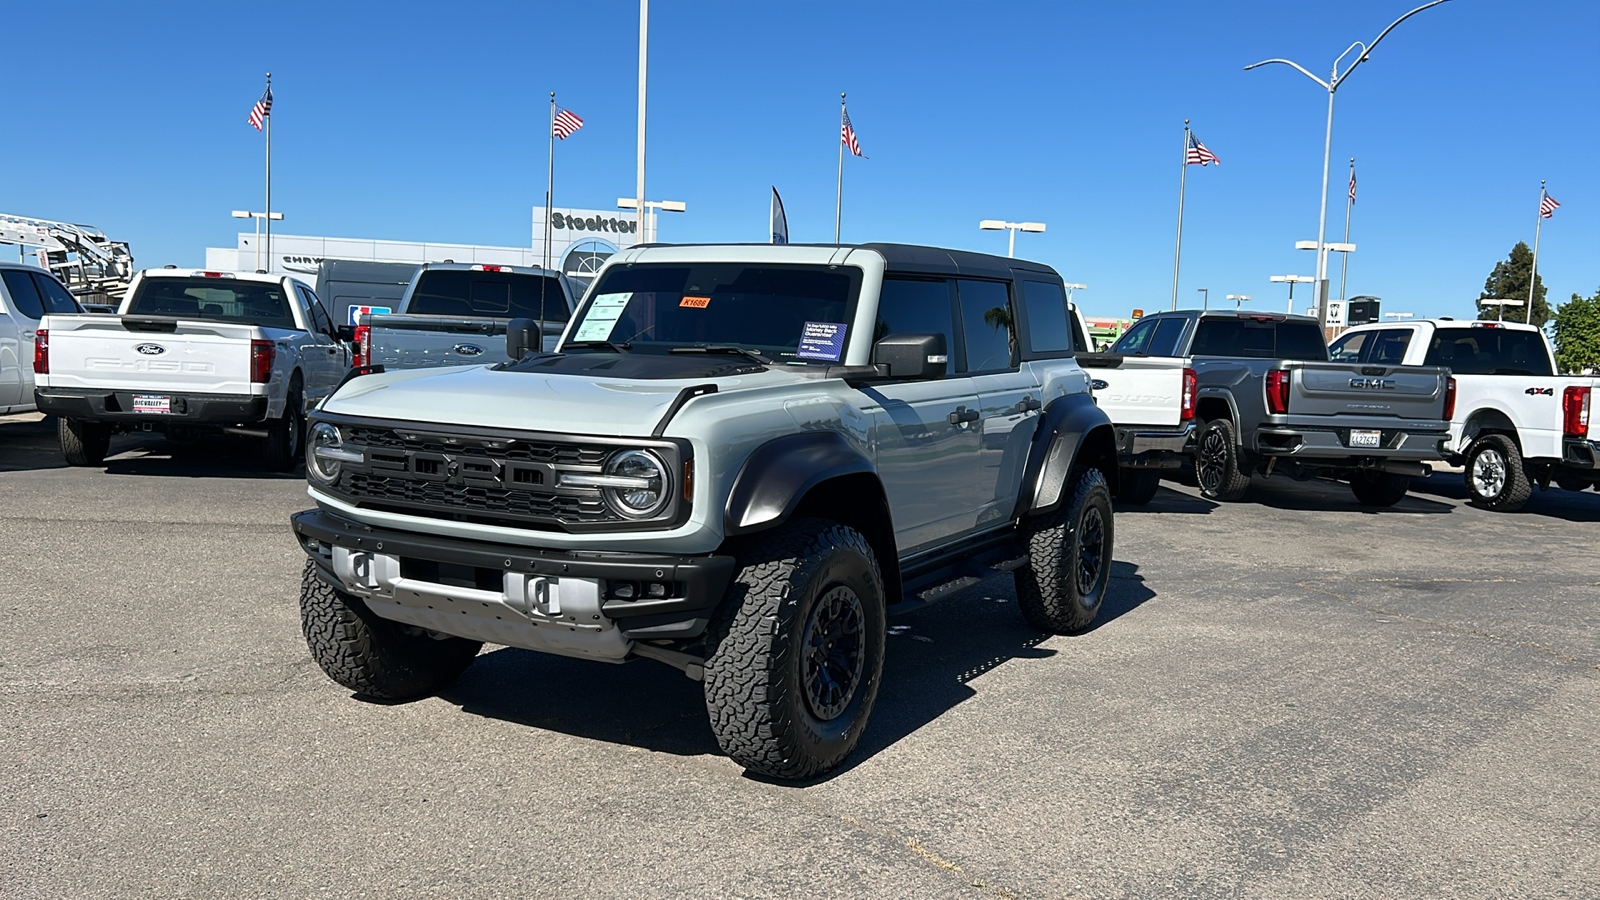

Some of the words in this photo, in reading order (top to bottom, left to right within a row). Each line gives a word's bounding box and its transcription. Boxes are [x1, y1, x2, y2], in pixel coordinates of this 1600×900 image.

[552, 212, 638, 234] Stockton
[141, 345, 161, 354] Ford
[85, 357, 215, 374] F-150
[1348, 378, 1396, 390] GMC
[1108, 394, 1173, 404] DUTY
[365, 447, 556, 492] FORD
